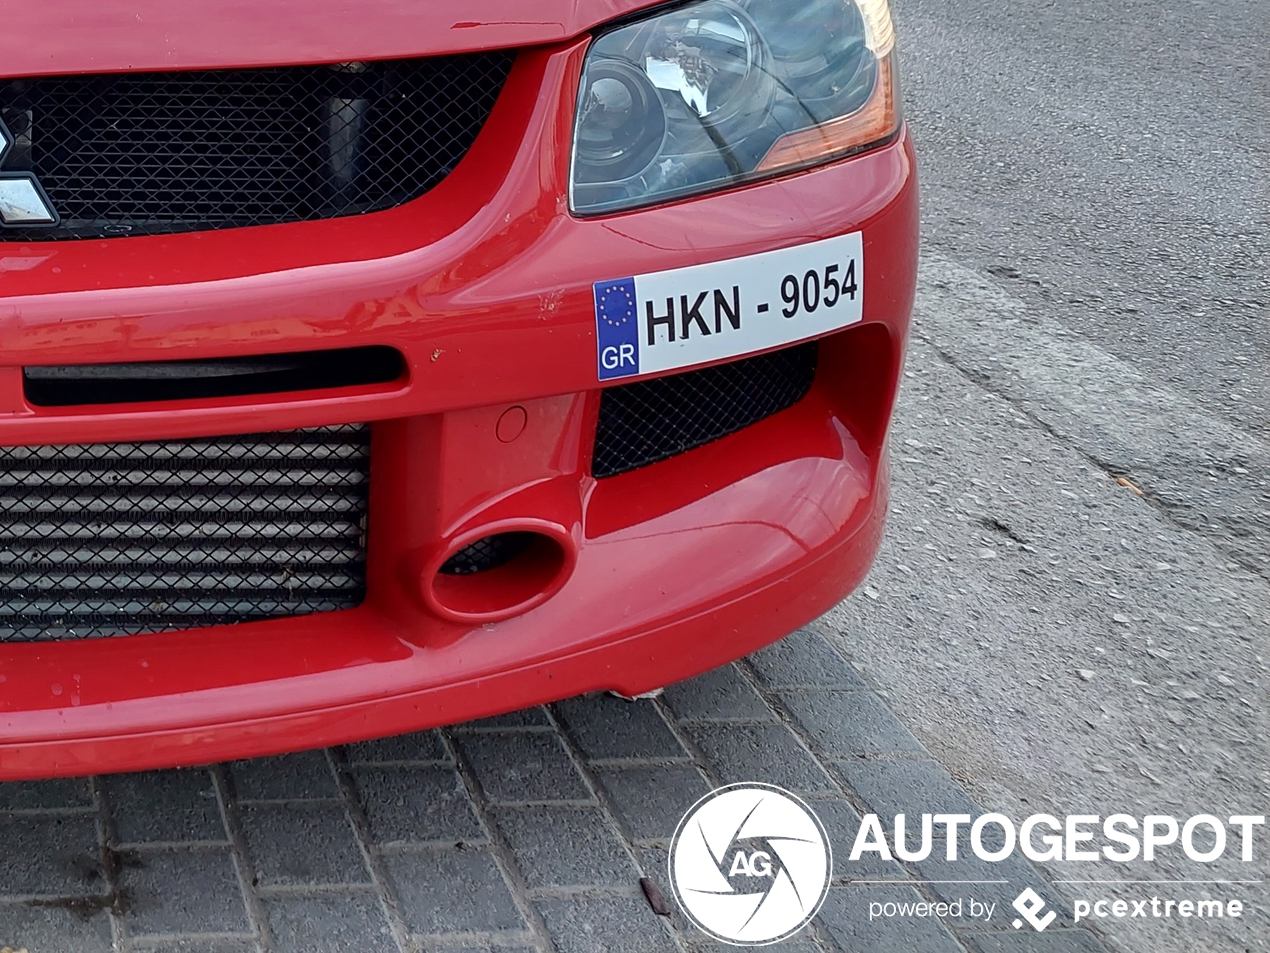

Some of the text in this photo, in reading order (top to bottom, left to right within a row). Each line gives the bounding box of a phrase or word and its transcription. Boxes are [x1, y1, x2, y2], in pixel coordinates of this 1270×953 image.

[645, 285, 741, 346] HKN
[781, 258, 858, 319] 9054
[600, 344, 636, 370] GR
